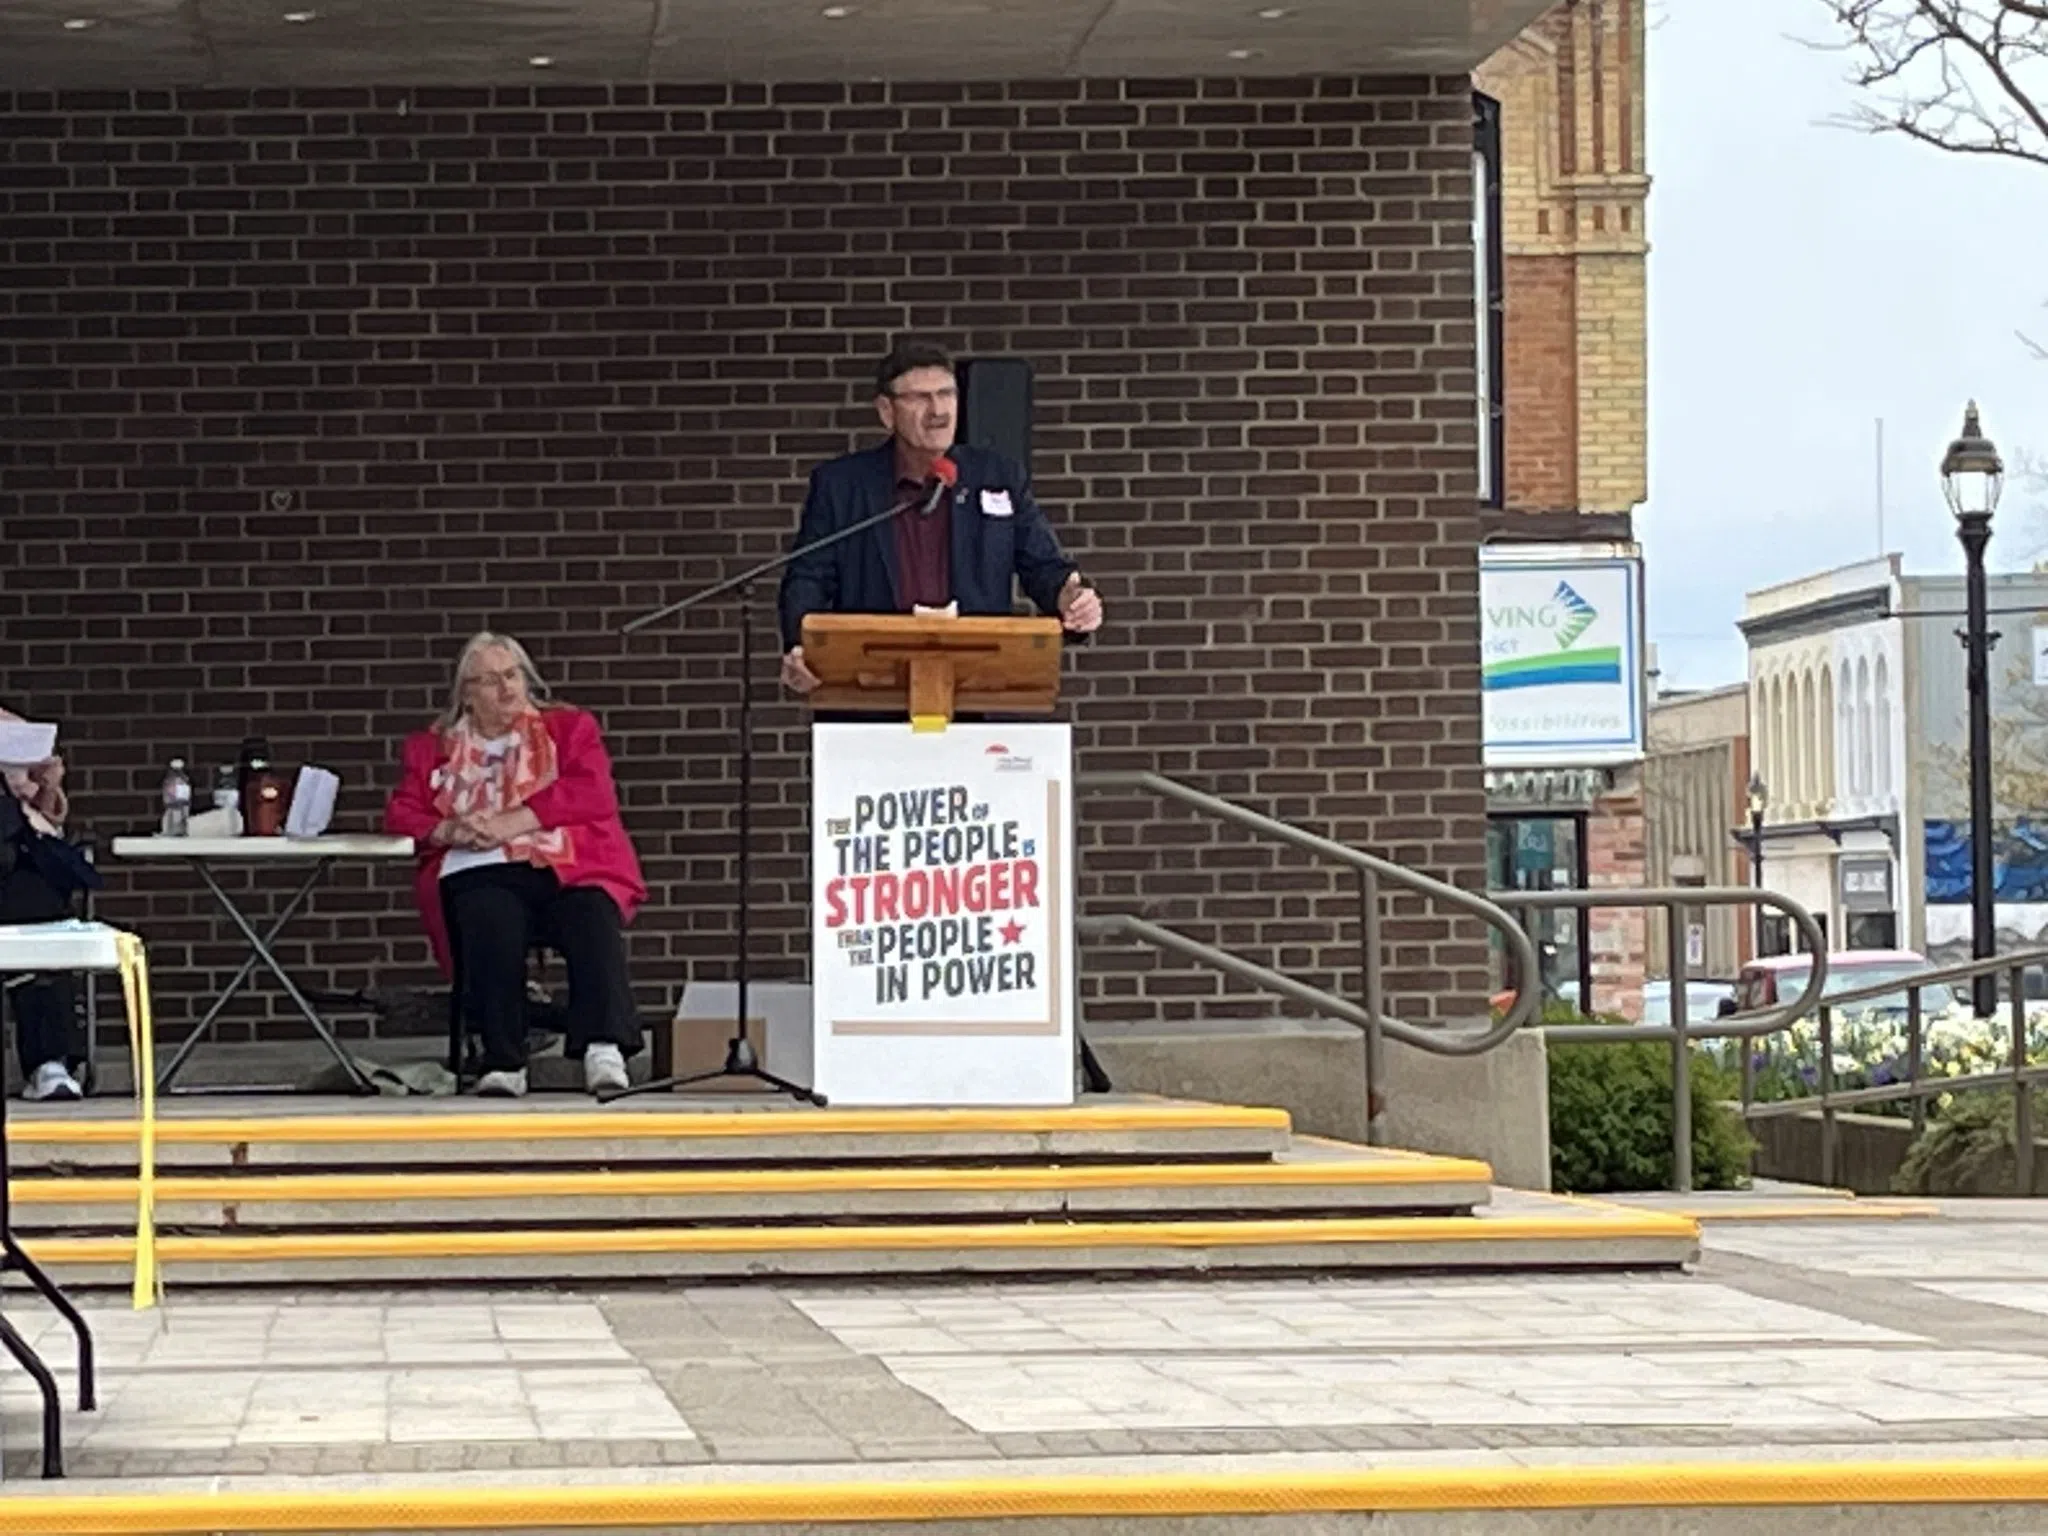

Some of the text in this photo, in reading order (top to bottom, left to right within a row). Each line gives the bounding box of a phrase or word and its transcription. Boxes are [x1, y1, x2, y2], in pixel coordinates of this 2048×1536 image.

[1486, 604, 1557, 628] VING
[855, 785, 968, 834] POWER
[972, 803, 989, 821] OF
[834, 835, 891, 876] THE
[903, 820, 1019, 870] PEOPLE
[825, 859, 1040, 929] STRONGER
[877, 916, 993, 964] PEOPLE
[876, 951, 1037, 1006] IN POWER
